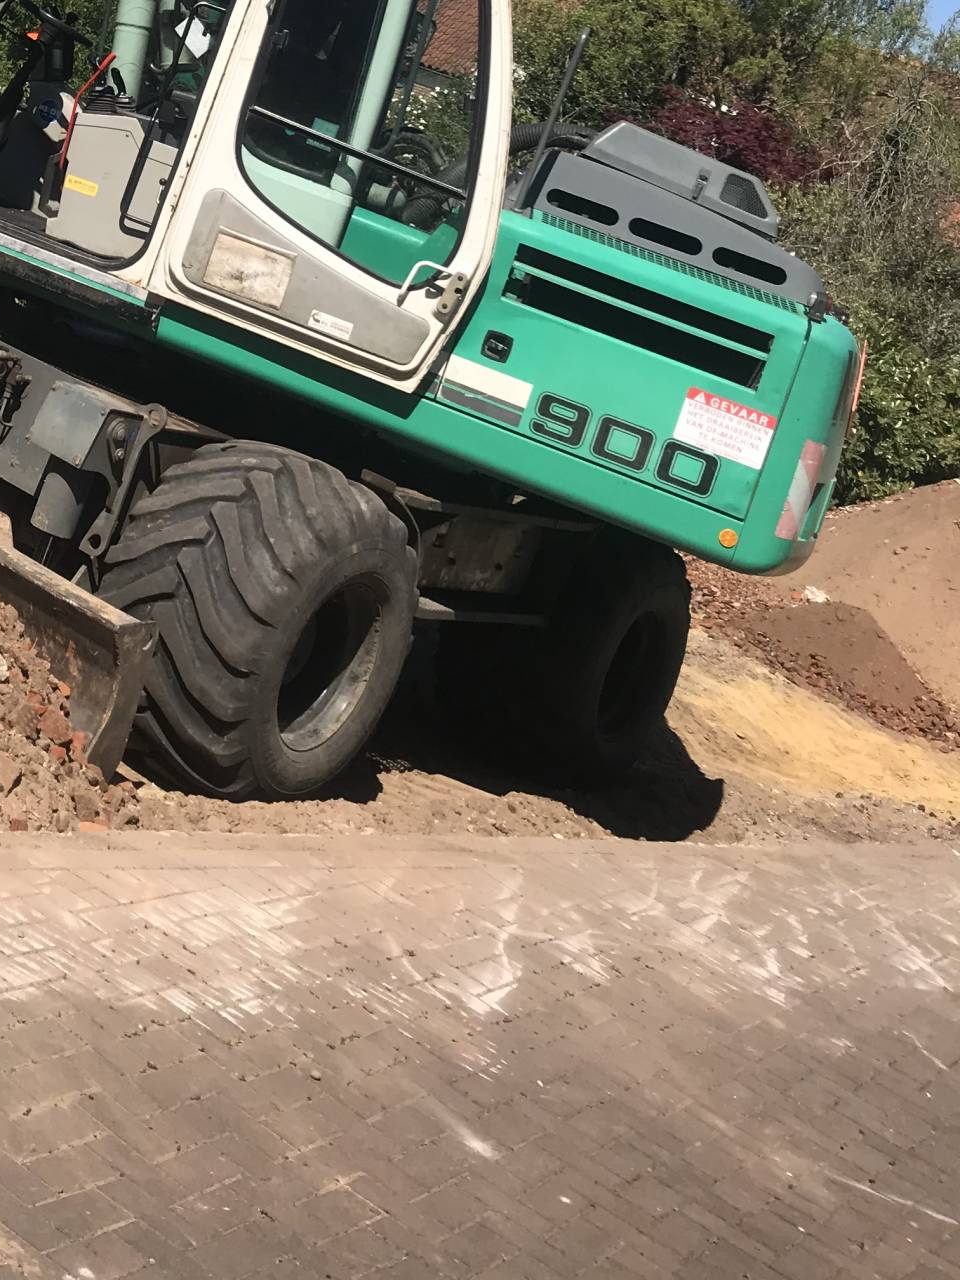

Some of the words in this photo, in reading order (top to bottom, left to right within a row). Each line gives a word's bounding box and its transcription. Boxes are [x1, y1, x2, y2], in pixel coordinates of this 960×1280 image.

[685, 417, 703, 429] VAN
[710, 397, 769, 427] GEVAAR
[529, 391, 721, 497] 900
[710, 436, 742, 452] KOMEN
